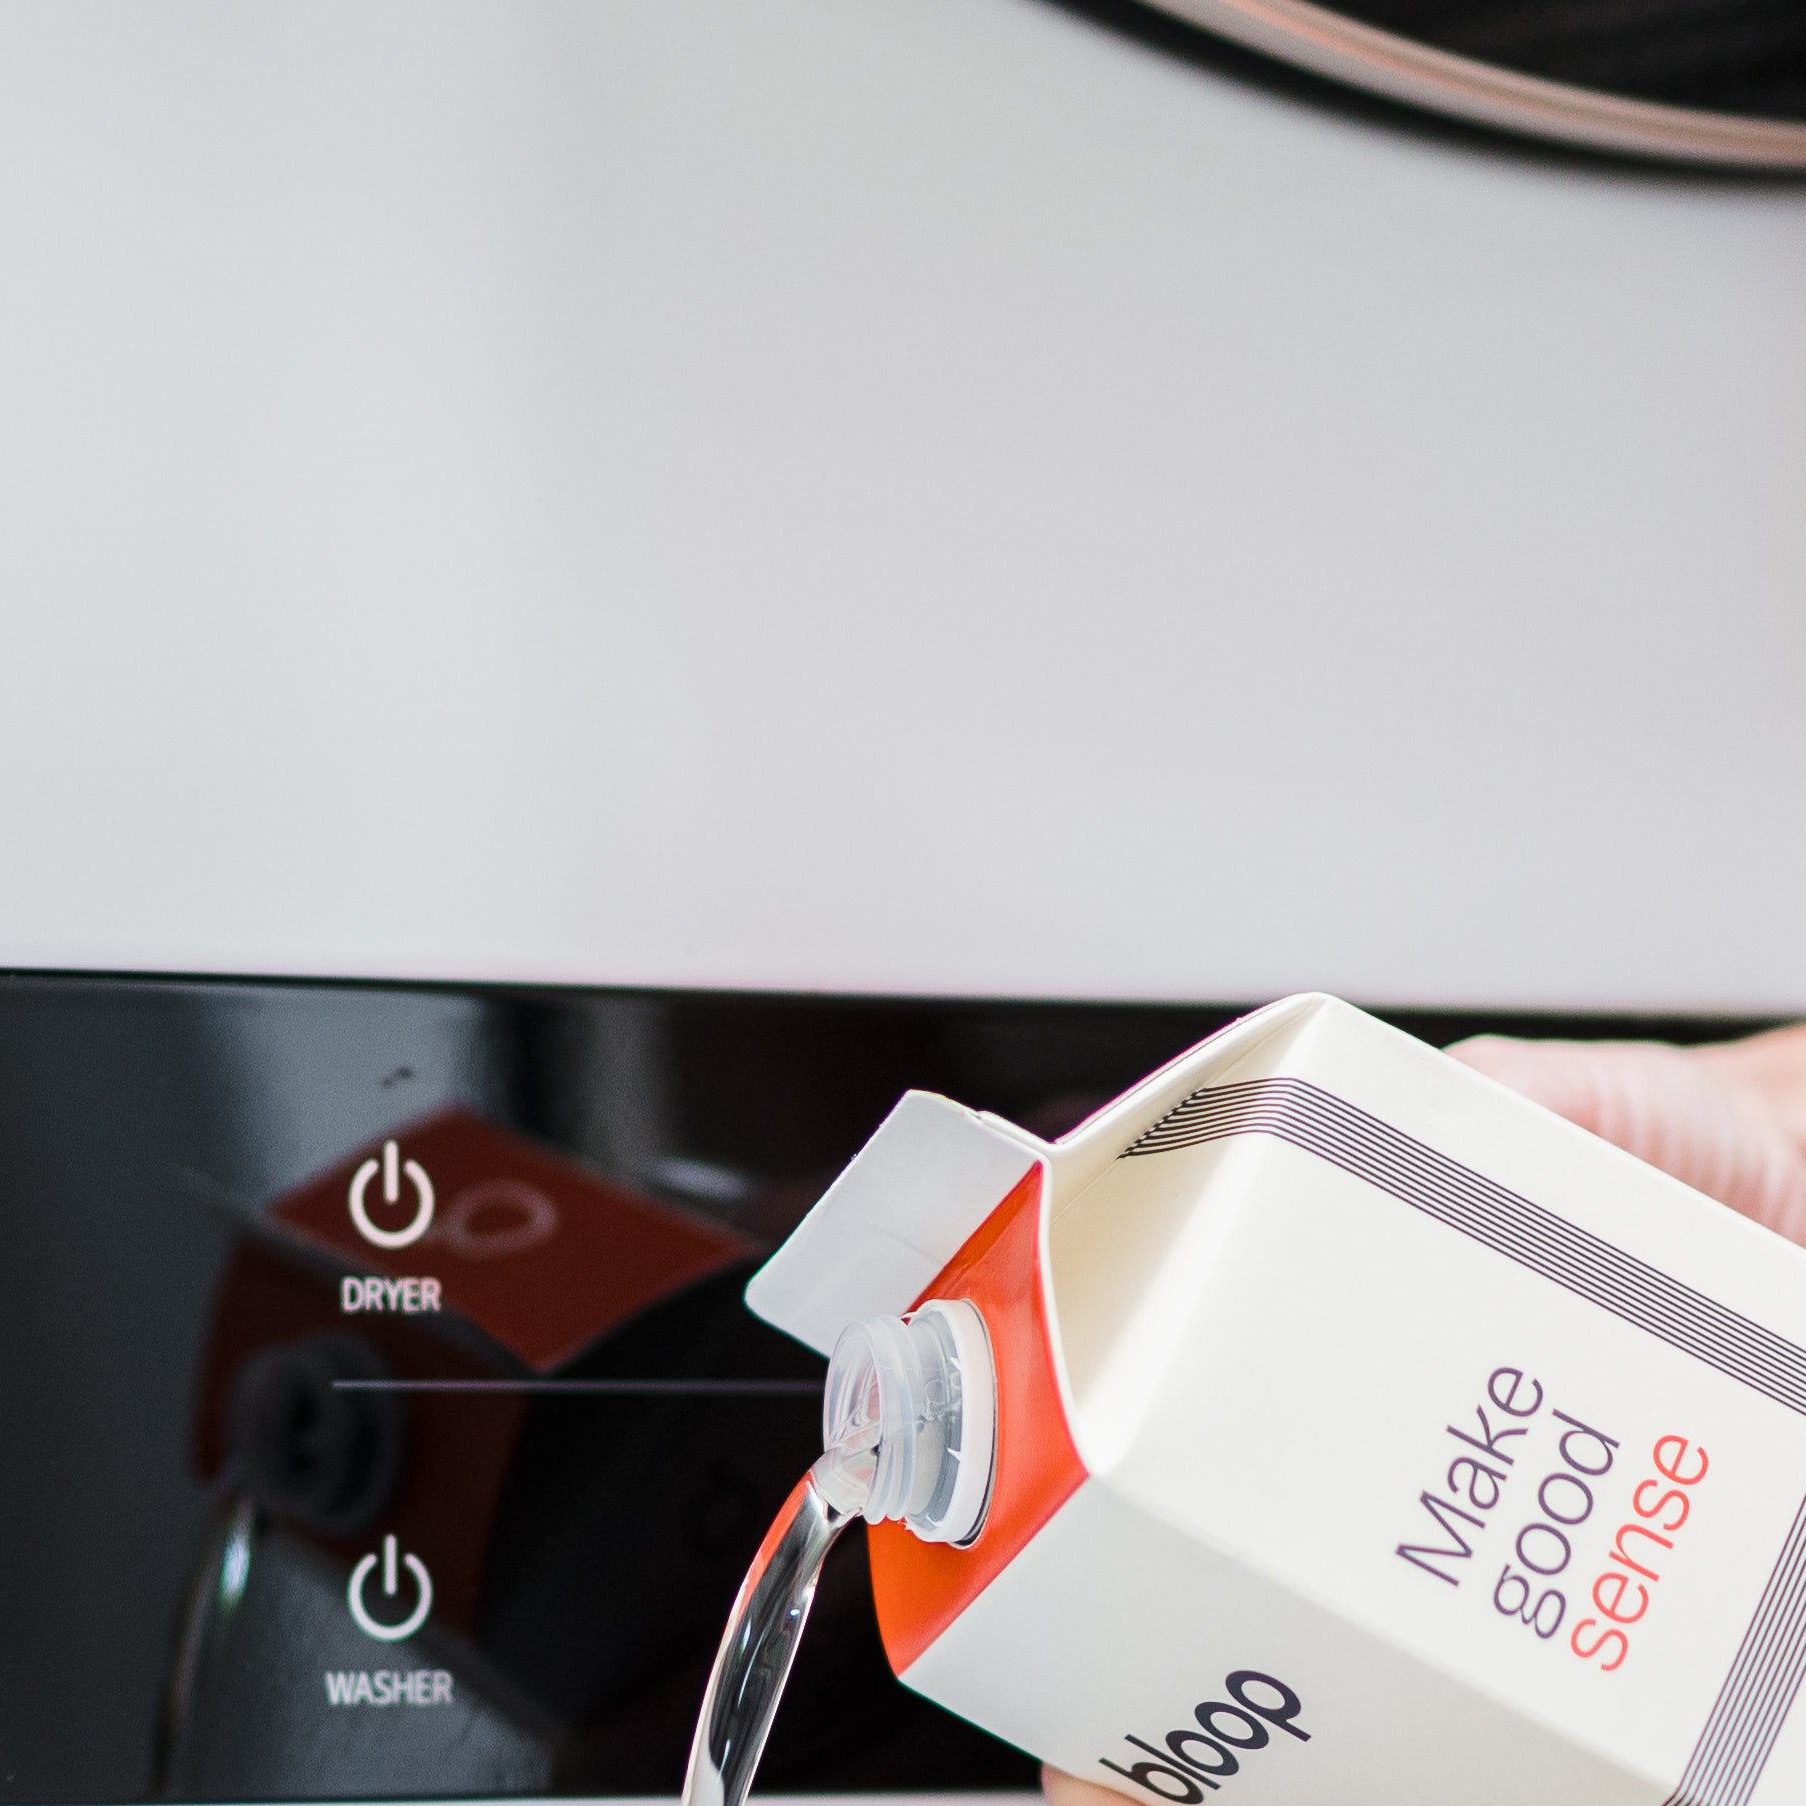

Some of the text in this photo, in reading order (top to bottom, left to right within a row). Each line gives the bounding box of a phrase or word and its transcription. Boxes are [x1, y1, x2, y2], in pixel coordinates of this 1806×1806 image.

[341, 1277, 442, 1312] DRYER
[1395, 1366, 1543, 1587] Make
[1492, 1409, 1620, 1640] good
[1570, 1434, 1709, 1671] sense
[326, 1671, 453, 1706] WASHER
[1099, 1670, 1312, 1805] bloop
